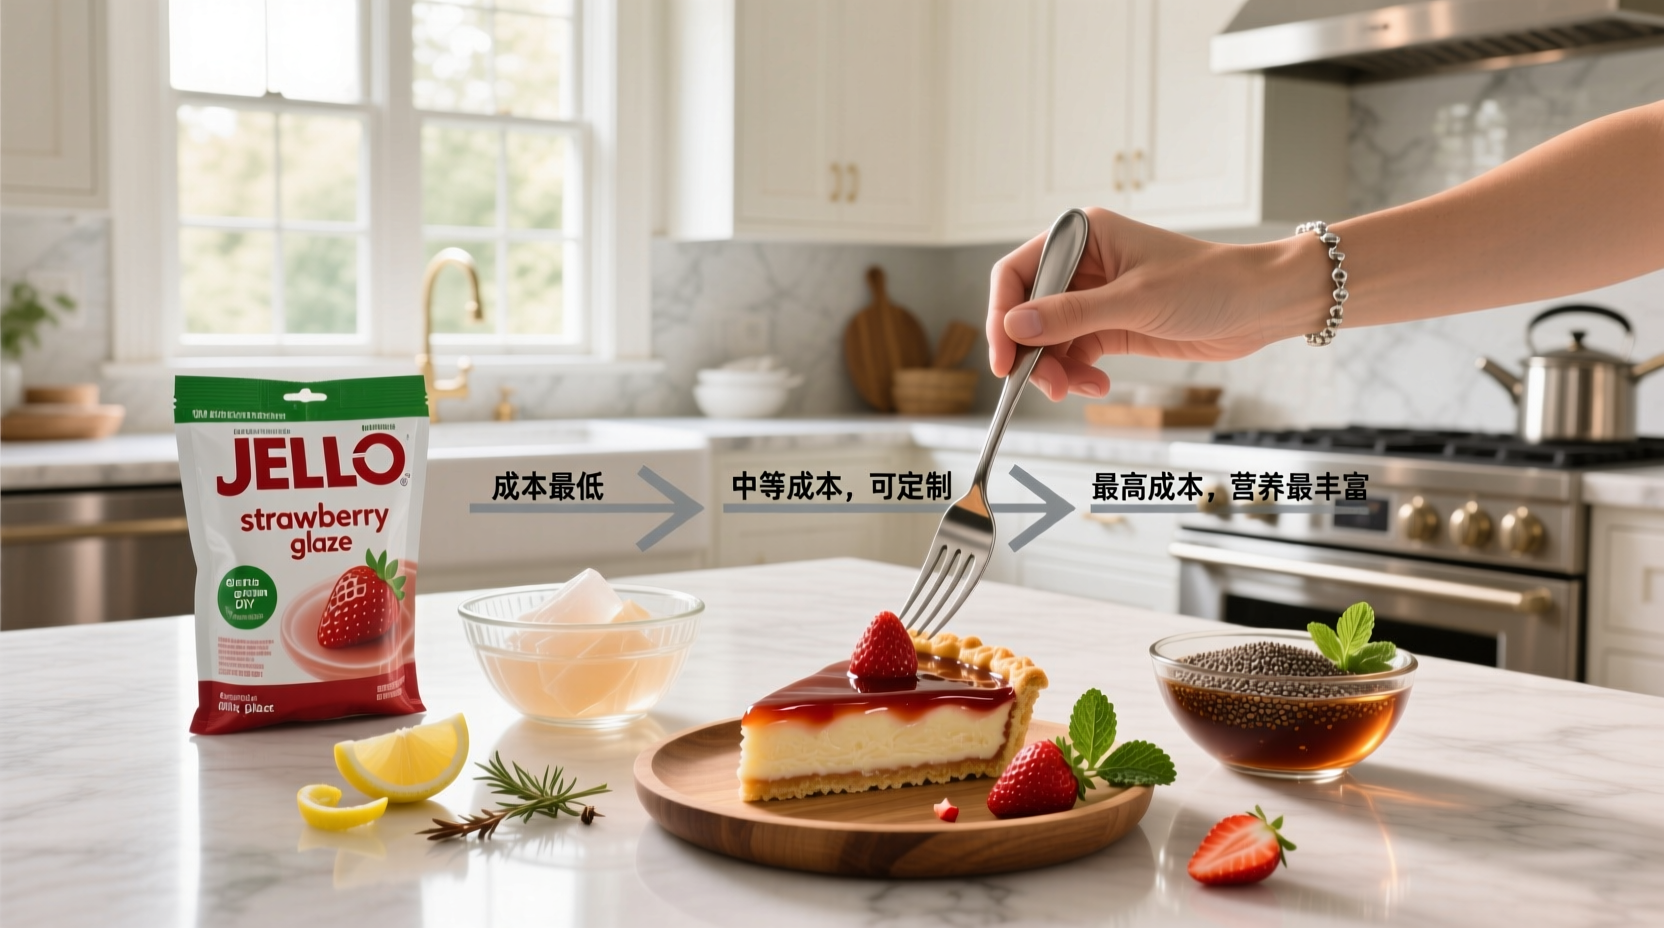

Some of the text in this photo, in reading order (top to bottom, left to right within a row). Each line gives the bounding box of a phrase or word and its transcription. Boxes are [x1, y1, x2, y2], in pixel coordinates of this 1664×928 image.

[217, 432, 406, 497] JELLO
[240, 502, 389, 533] strawberry
[290, 530, 353, 560] glaze
